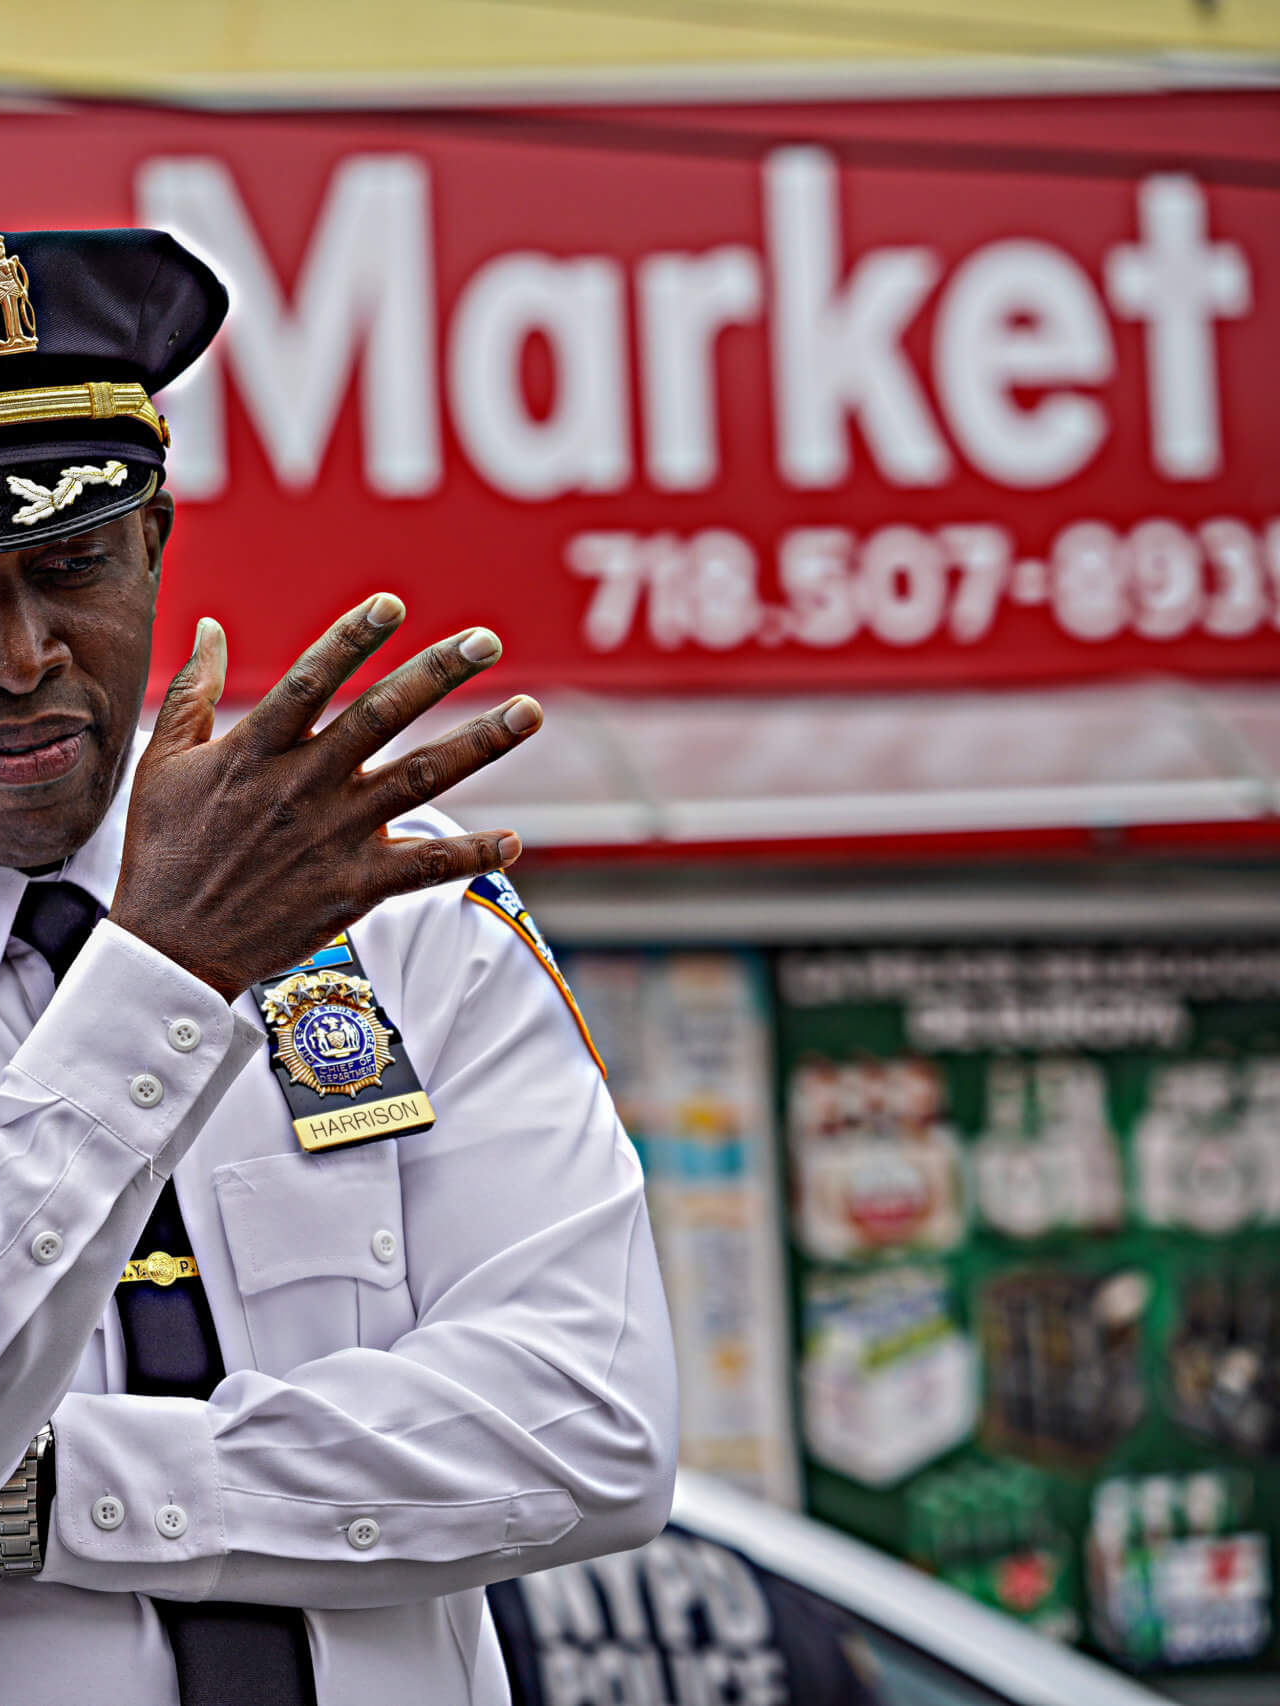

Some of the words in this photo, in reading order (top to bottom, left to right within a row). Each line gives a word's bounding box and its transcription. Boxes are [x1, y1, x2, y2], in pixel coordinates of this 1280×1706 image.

[133, 145, 1254, 502] Market
[356, 1015, 375, 1050] POLICE
[319, 1064, 376, 1083] DEPARTMENT
[320, 1061, 355, 1075] CHIEF
[359, 1055, 372, 1066] OF
[310, 1100, 420, 1140] HARRISON
[517, 1533, 771, 1648] NYPD
